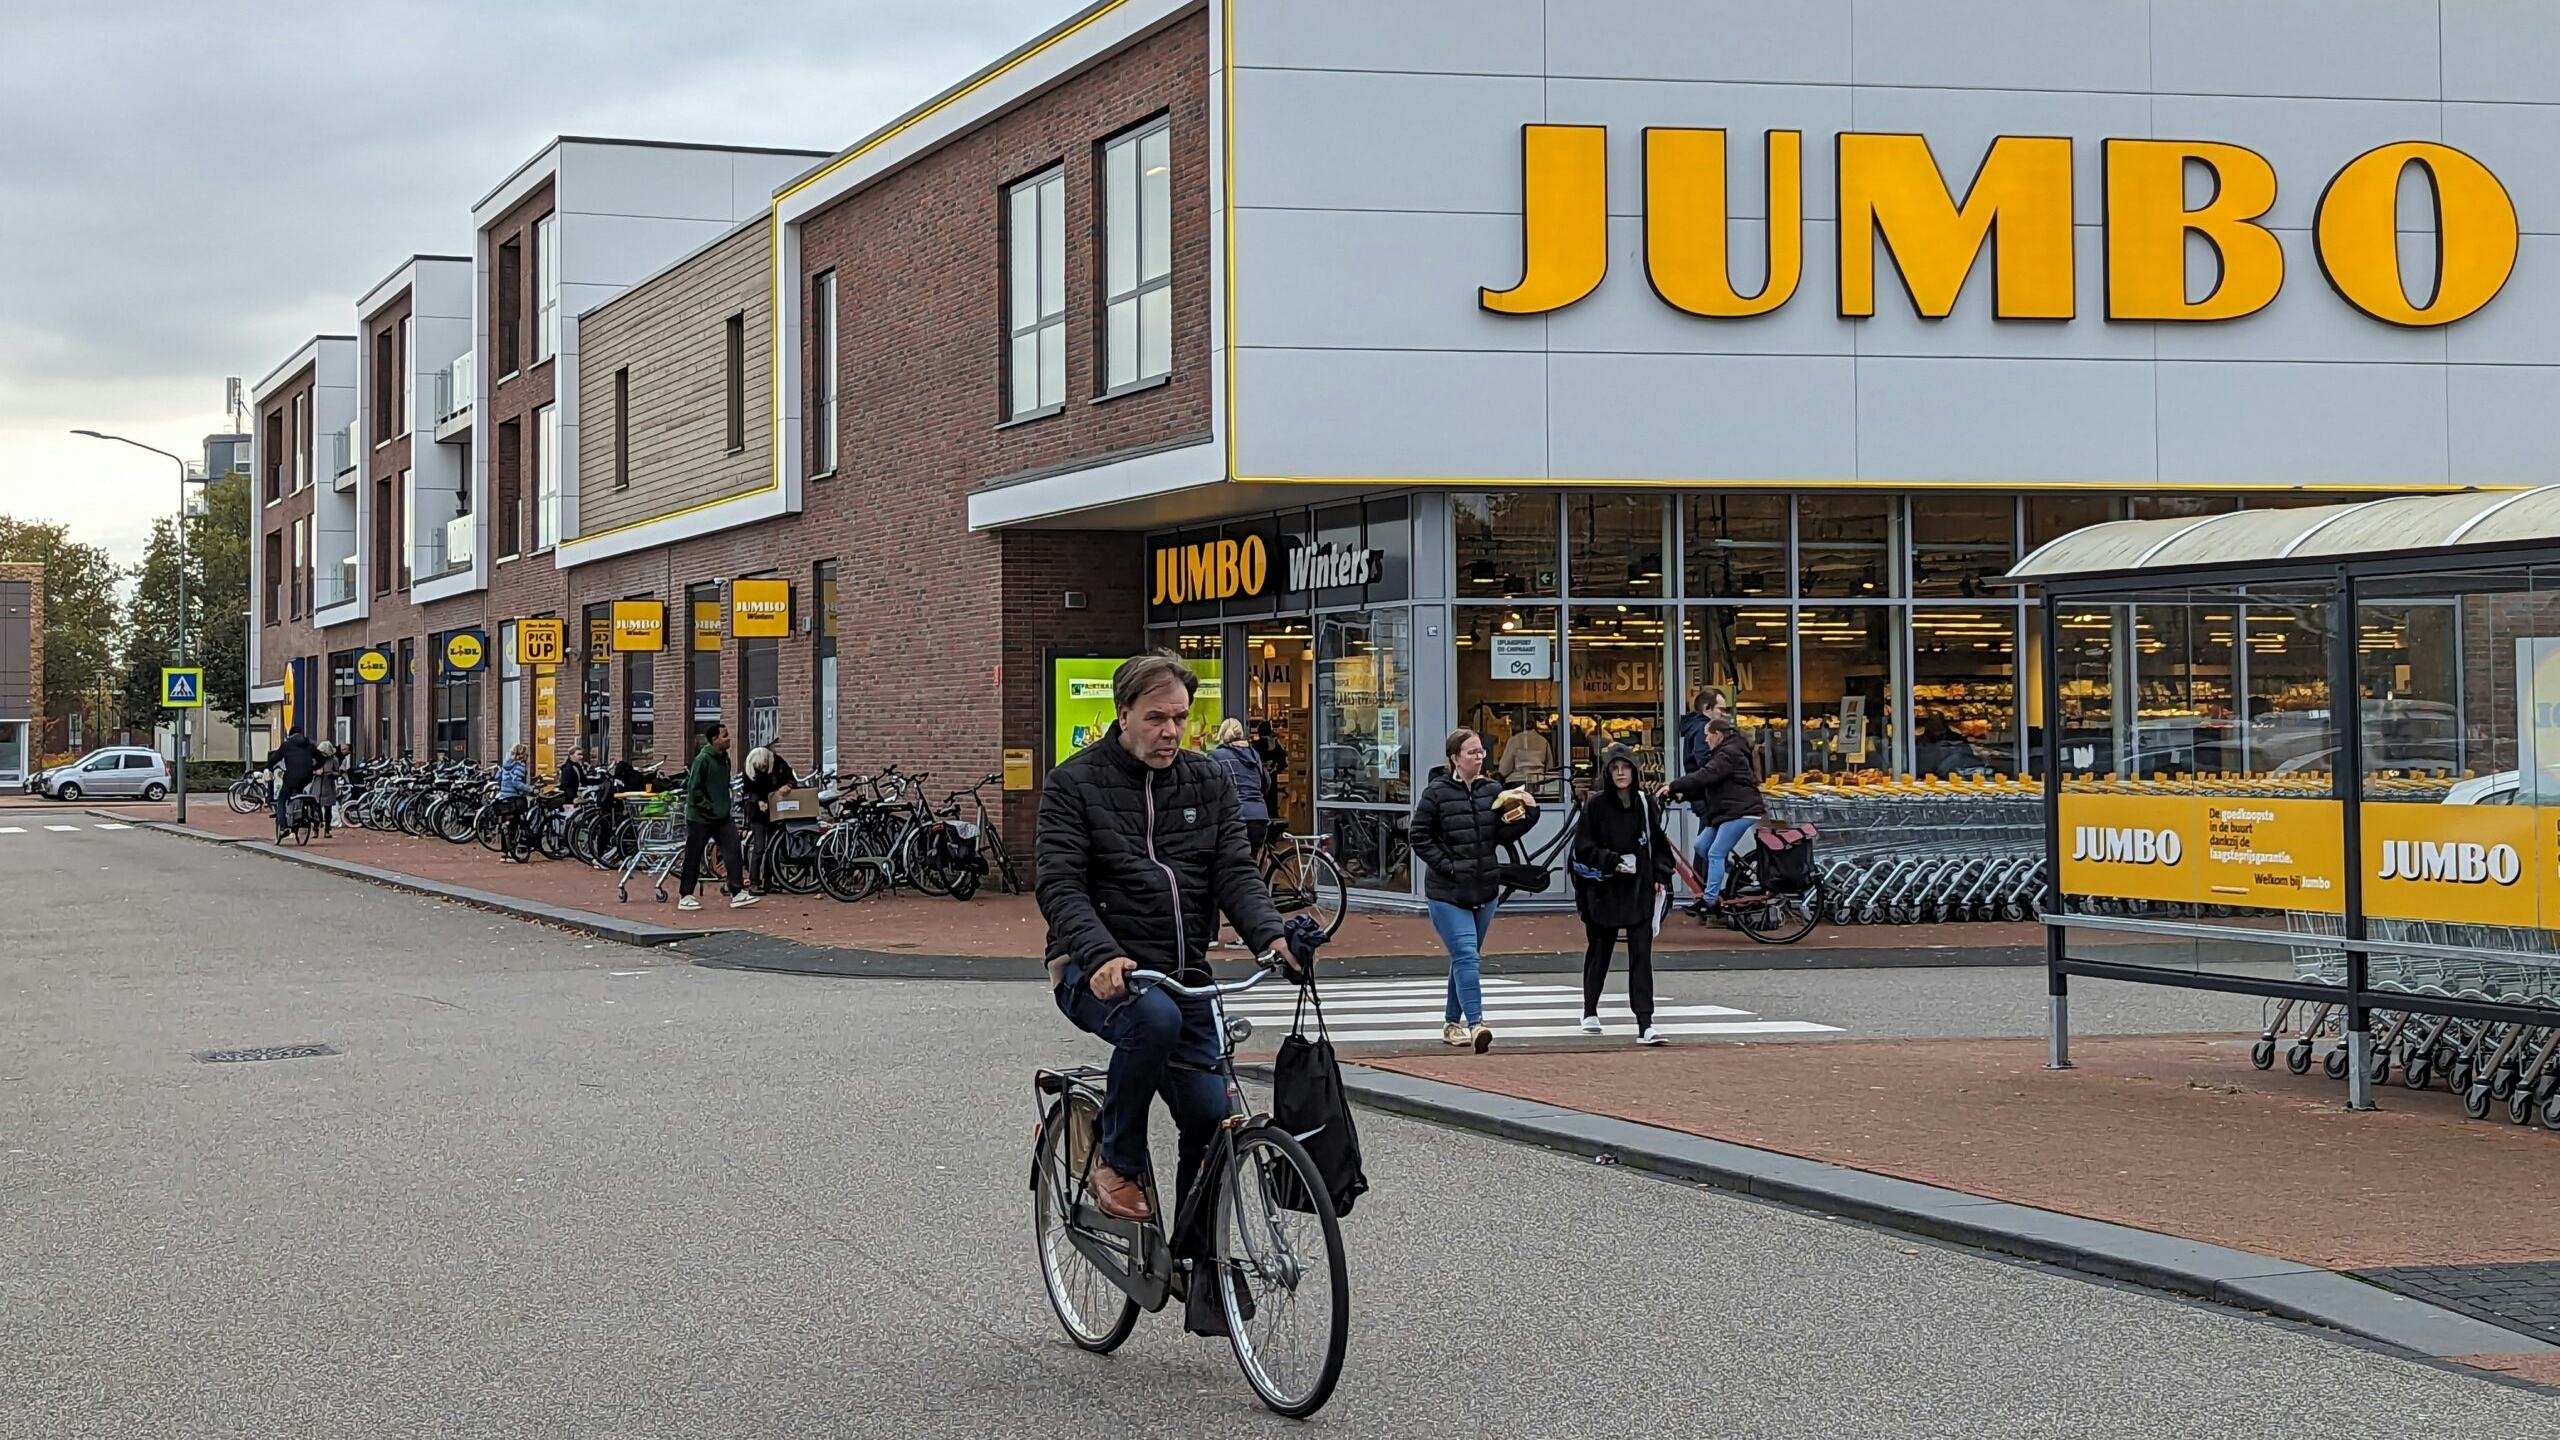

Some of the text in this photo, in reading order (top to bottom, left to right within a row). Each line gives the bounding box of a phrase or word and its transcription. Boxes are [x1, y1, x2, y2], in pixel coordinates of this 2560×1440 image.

[1478, 123, 2520, 328] JUMBO
[1152, 534, 1370, 606] JUMBO Winters
[735, 601, 786, 613] JUMBO
[616, 619, 662, 631] JUMBO
[528, 633, 553, 642] PICK
[450, 645, 480, 656] LIDL
[528, 643, 554, 658] UP
[360, 660, 386, 671] LIDL
[2209, 808, 2274, 824] De goedkoopste
[2209, 820, 2253, 834] in de buurt
[2072, 826, 2182, 866] JUMBO
[2210, 835, 2250, 849] dankzij de
[2210, 849, 2293, 865] laagsteprijsgarantie.
[2377, 840, 2522, 885] JUMBO
[2254, 873, 2330, 890] Welkom bij Jumbo
